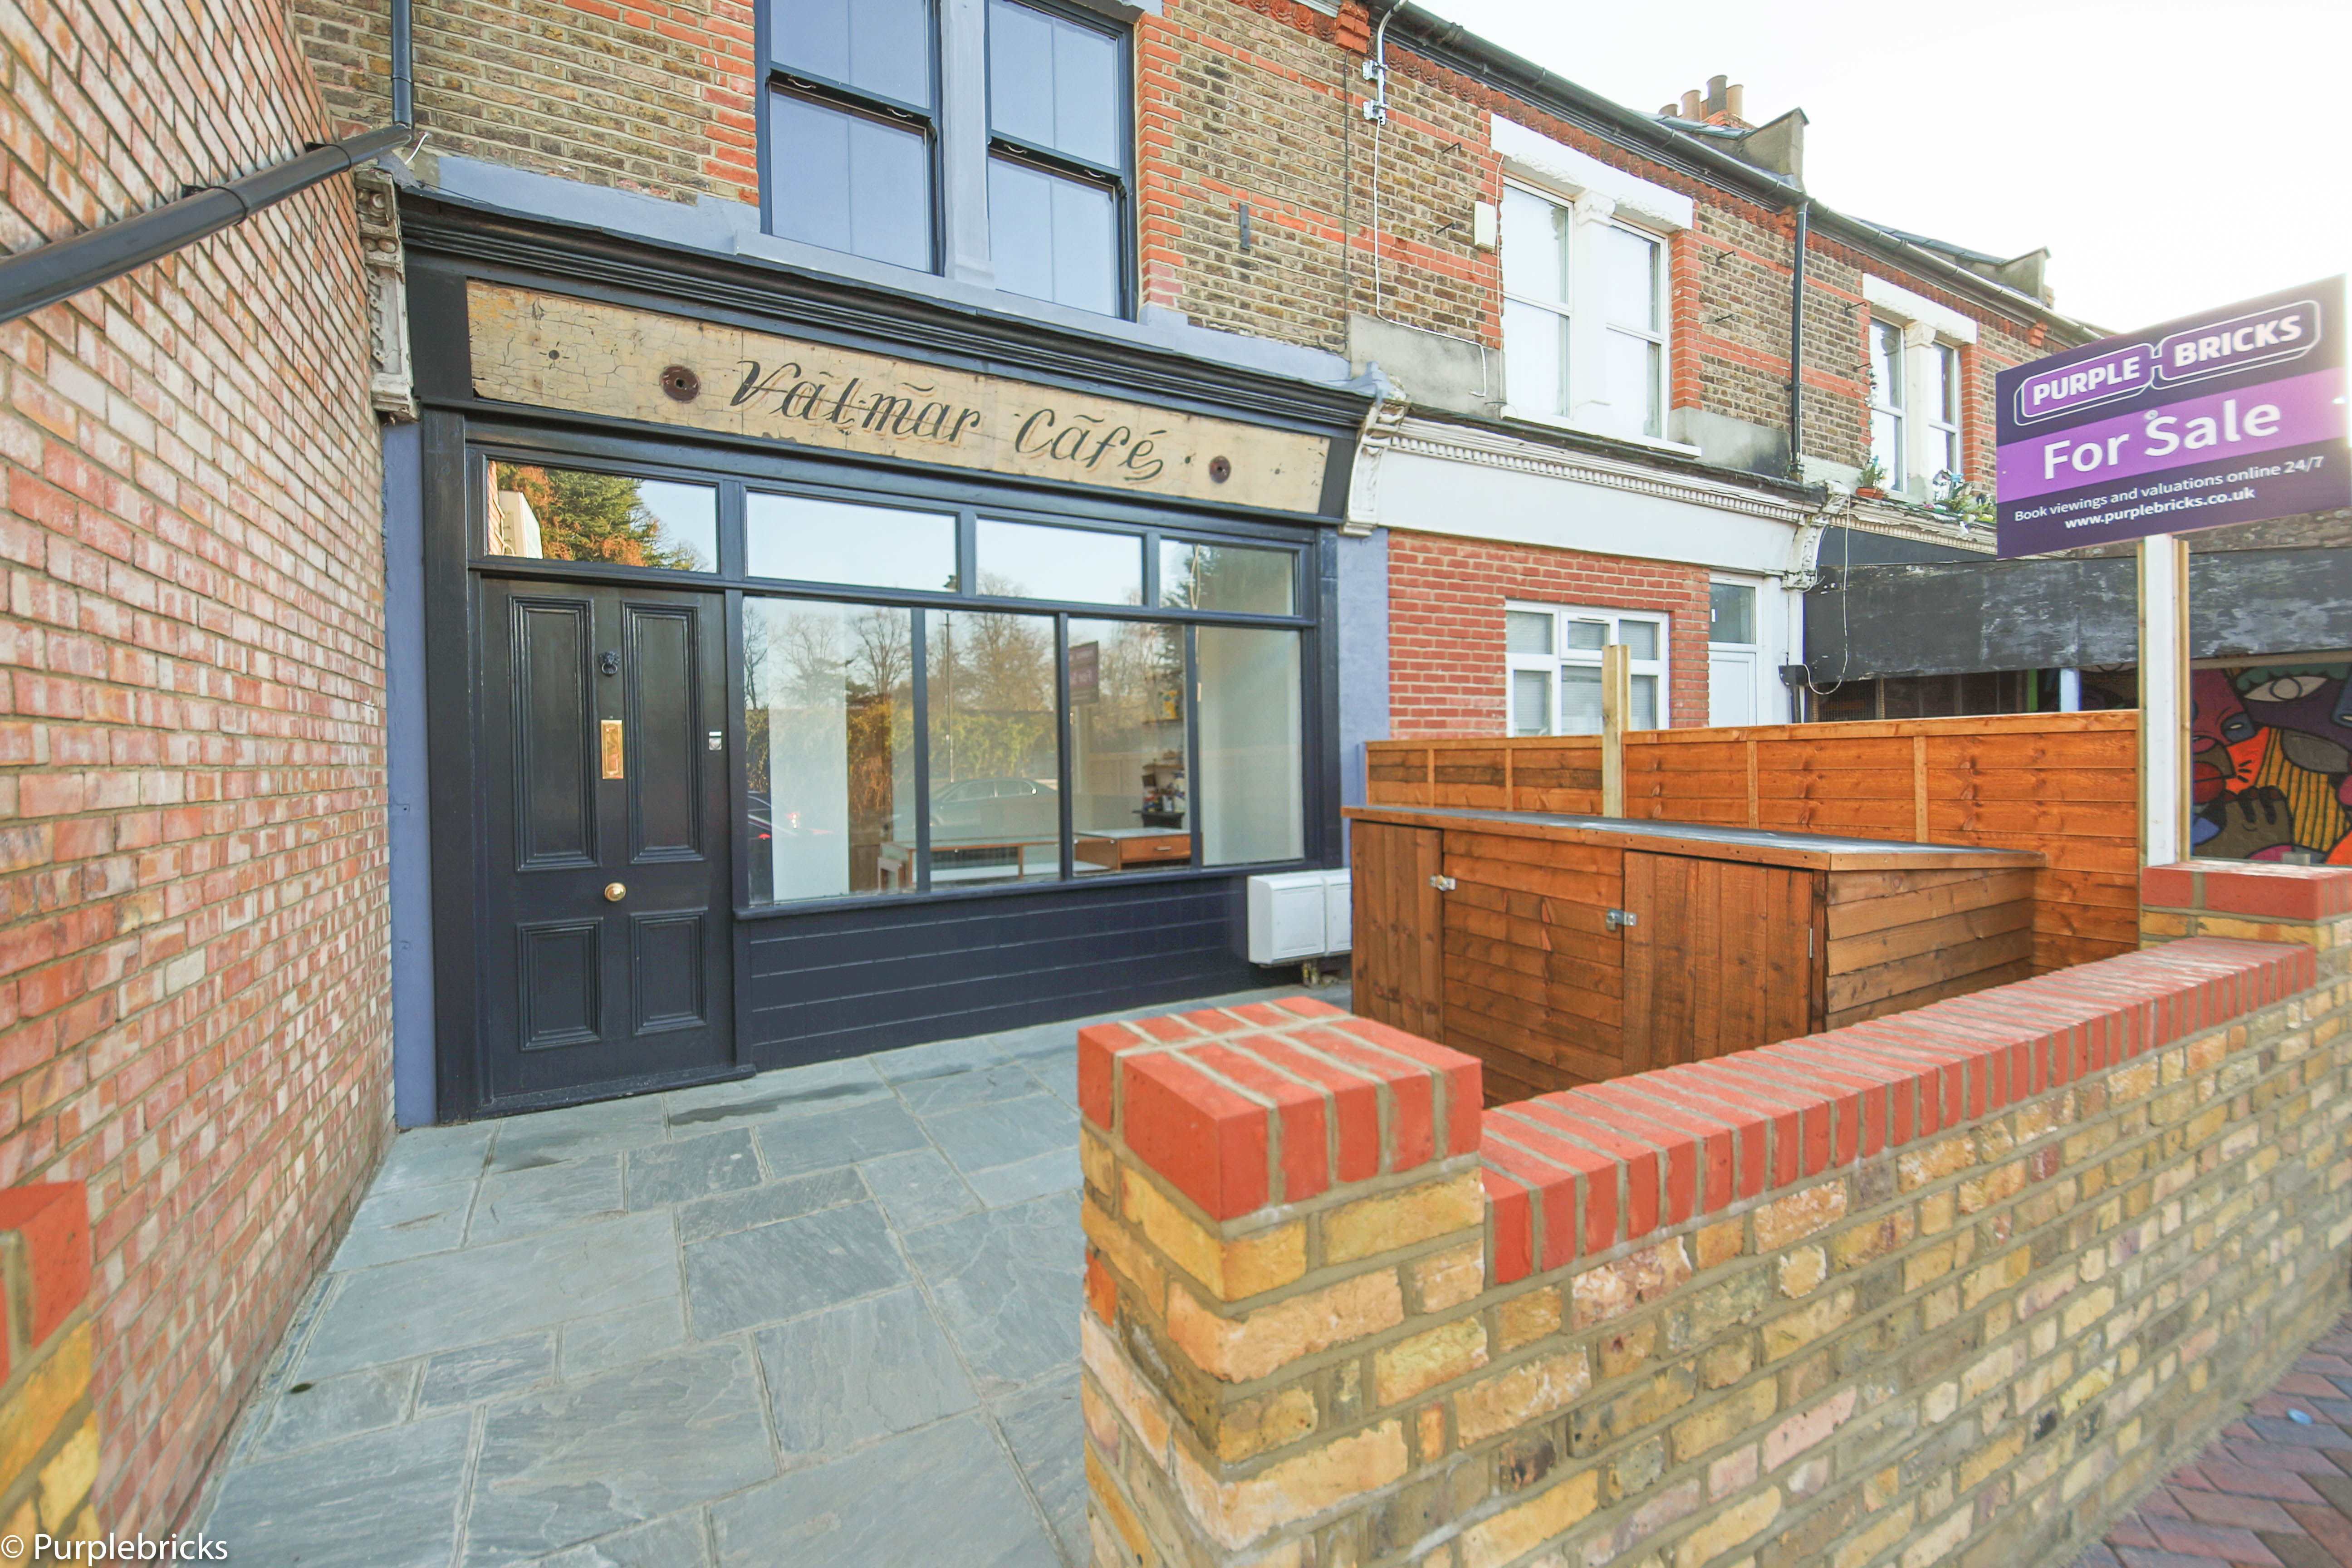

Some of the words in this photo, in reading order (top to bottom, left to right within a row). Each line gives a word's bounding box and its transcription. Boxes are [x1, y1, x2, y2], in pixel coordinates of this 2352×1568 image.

[2033, 356, 2140, 406] PURPLE
[2174, 315, 2303, 367] BRICKS
[2044, 433, 2130, 480] For
[2144, 399, 2281, 457] Sale
[2014, 506, 2048, 522] Book
[2049, 495, 2108, 515] viewings
[2110, 487, 2138, 504] and
[2140, 475, 2224, 497] valuations
[2225, 465, 2281, 483] online
[2283, 455, 2324, 474] 24/7
[2065, 486, 2256, 529] www.purplebricks.co.uk
